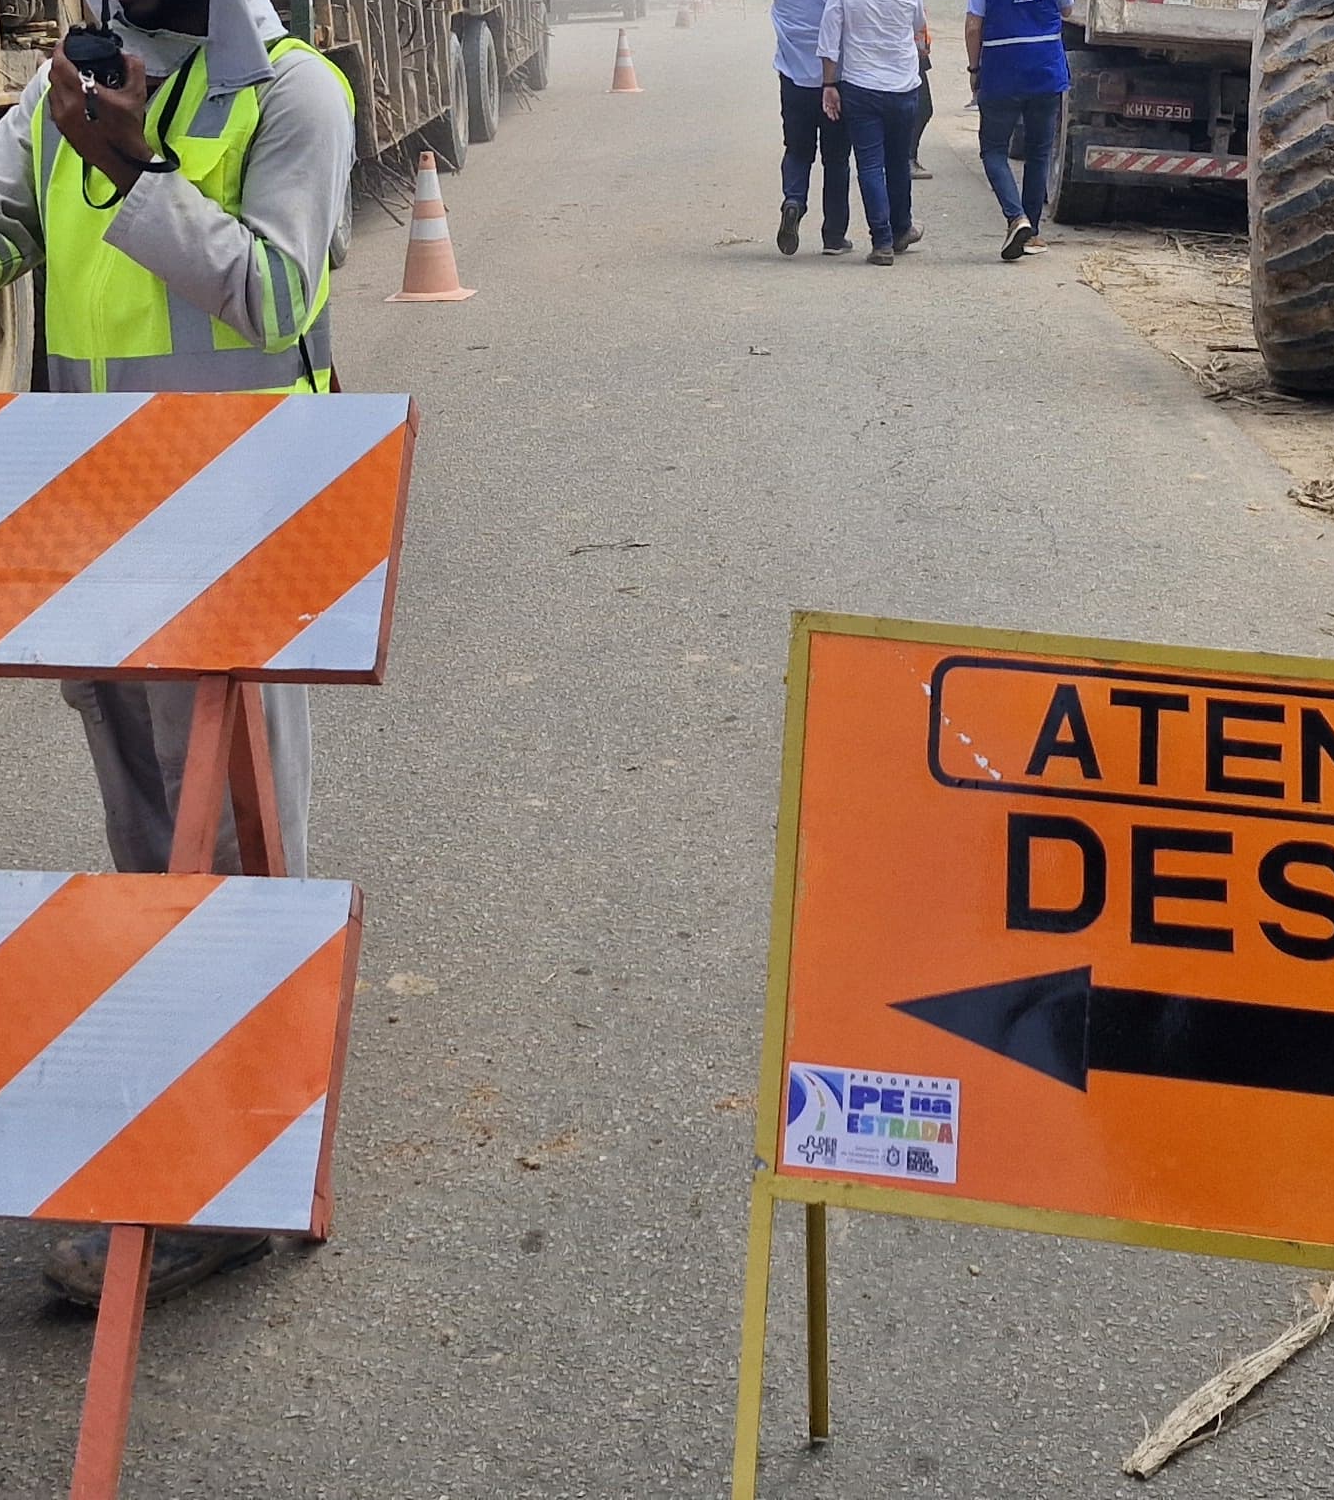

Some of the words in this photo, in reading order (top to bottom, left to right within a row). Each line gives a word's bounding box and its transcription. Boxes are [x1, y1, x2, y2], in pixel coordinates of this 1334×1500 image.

[1126, 102, 1152, 117] KHV
[850, 1073, 953, 1091] PROGRAMA
[849, 1085, 906, 1115] PE
[846, 1112, 954, 1145] ESTRADA
